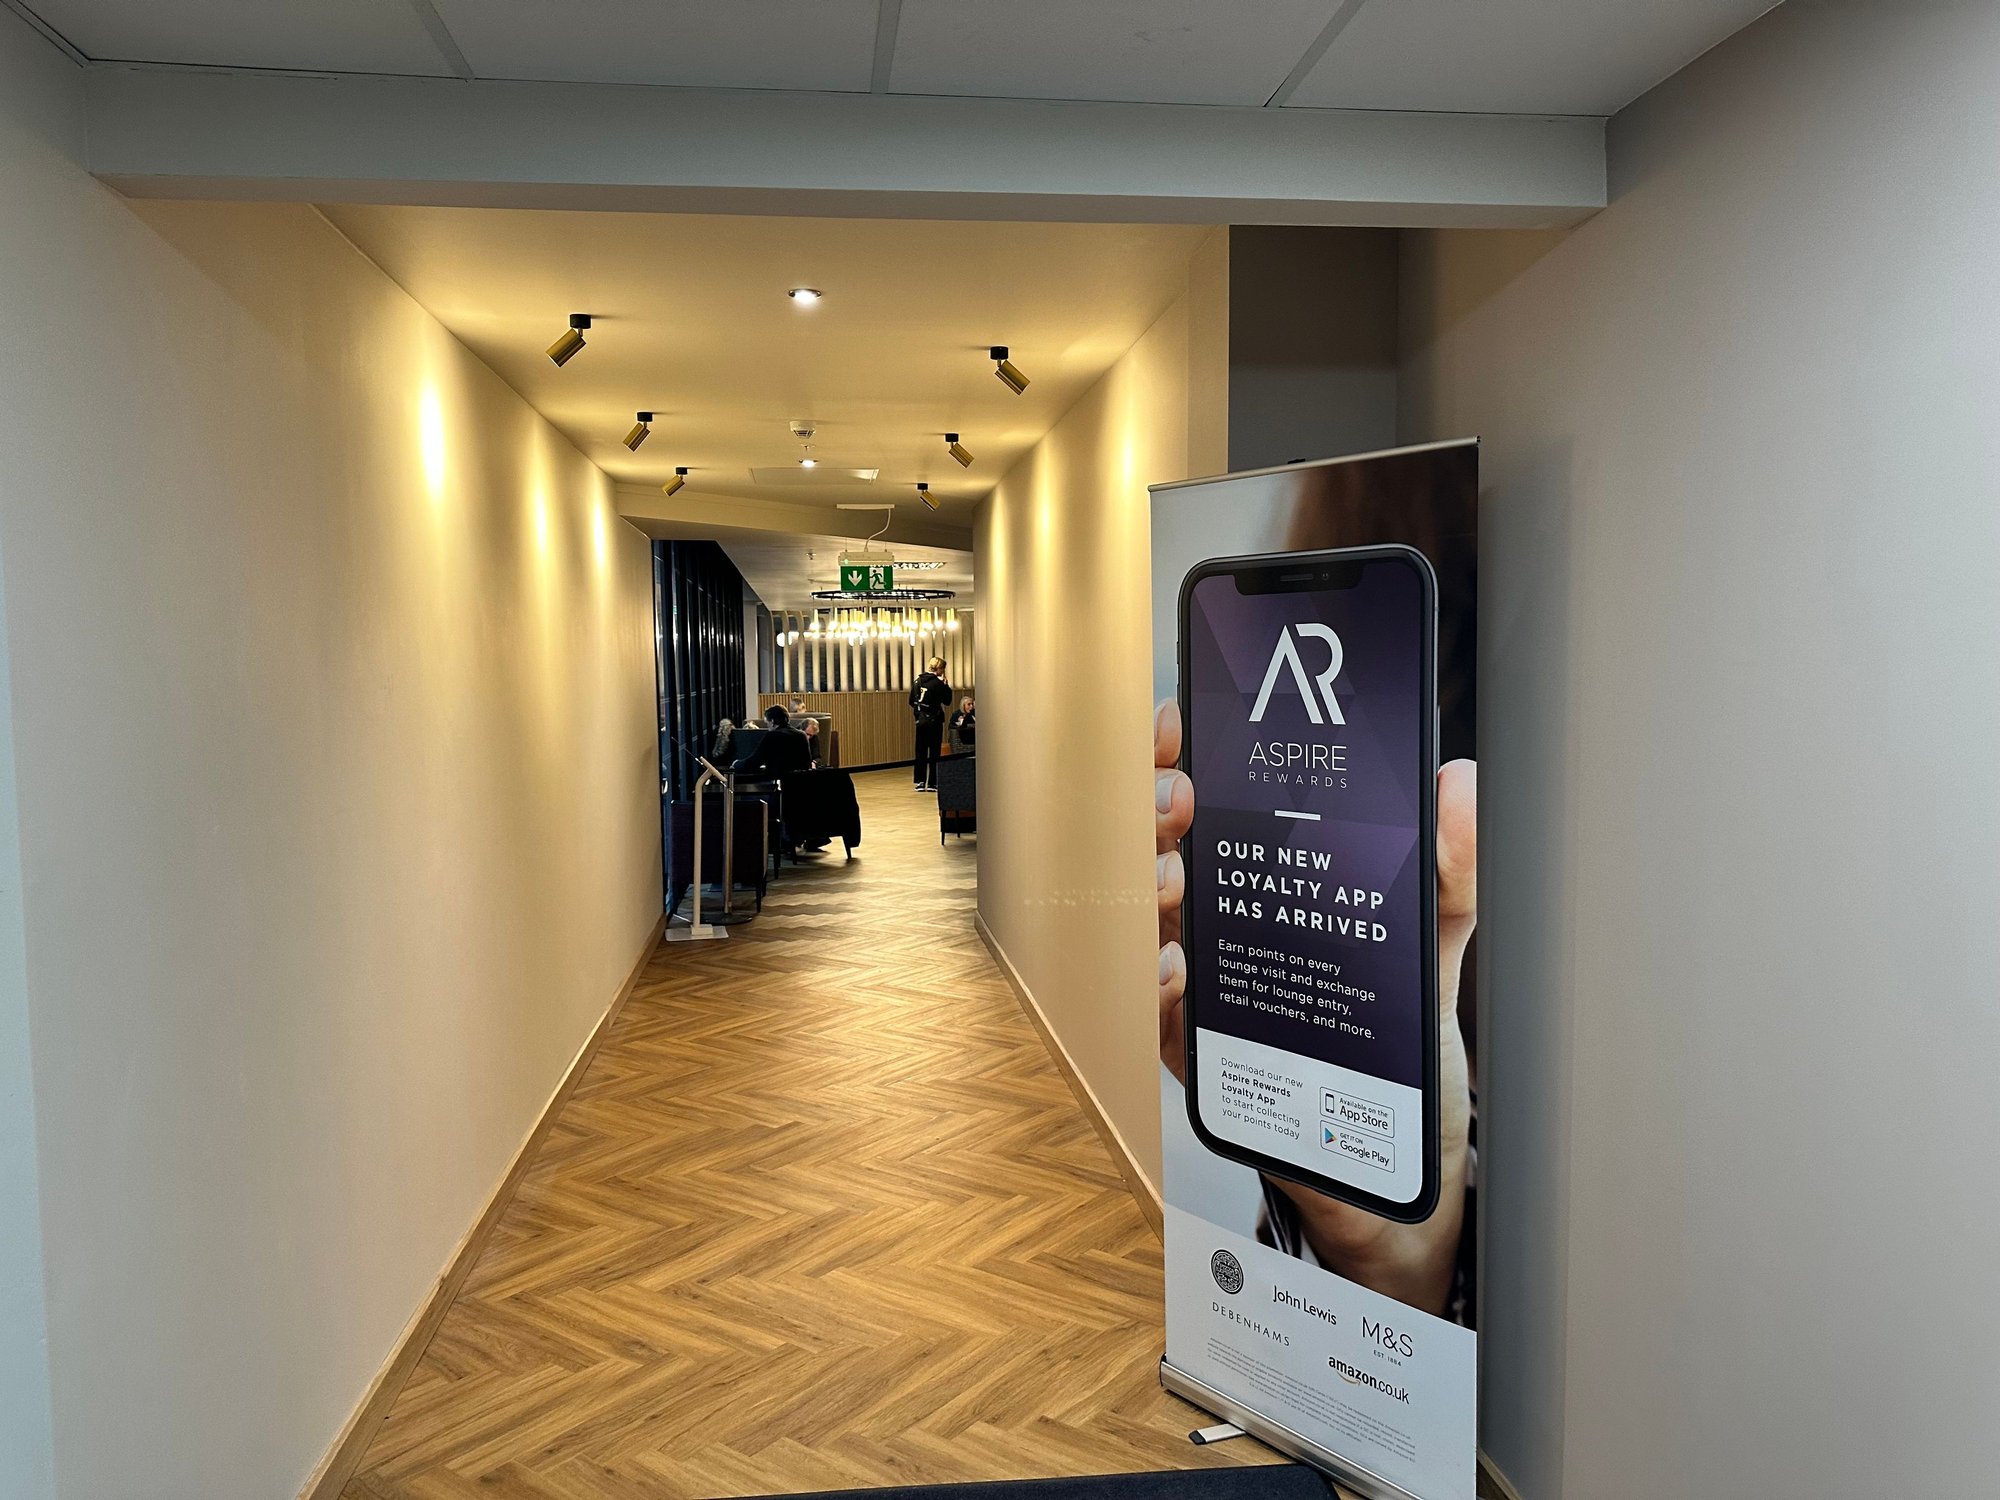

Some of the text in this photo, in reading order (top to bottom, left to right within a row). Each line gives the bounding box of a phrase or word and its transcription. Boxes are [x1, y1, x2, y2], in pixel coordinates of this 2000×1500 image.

[1249, 622, 1346, 725] AR
[1249, 742, 1347, 771] ASPIRE
[1249, 772, 1347, 788] REWARDS
[1217, 840, 1332, 871] OUR NEW
[1218, 868, 1384, 910] LOYALTY APP
[1218, 896, 1388, 942] HAS ARRIVED
[1218, 939, 1341, 976] Earn points on every
[1218, 956, 1376, 1002] lounge visit and exchange
[1219, 973, 1352, 1016] them for lounge entry,
[1219, 991, 1376, 1040] retail vouchers, and more.
[1221, 1057, 1303, 1088] Download our new
[1221, 1070, 1291, 1098] Aspire Rewards
[1221, 1082, 1276, 1106] Loyalty App
[1340, 1097, 1366, 1112] Available
[1377, 1109, 1388, 1118] the
[1222, 1095, 1300, 1128] to start collecting
[1222, 1108, 1300, 1140] your points today
[1340, 1105, 1388, 1130] App Store
[1340, 1132, 1350, 1140] GET
[1340, 1140, 1389, 1166] Google Play
[1273, 1285, 1337, 1325] John Lewis
[1212, 1301, 1290, 1347] DEBENHAMS
[1363, 1316, 1412, 1357] M&S
[1328, 1356, 1409, 1405] amazon.co.uk
